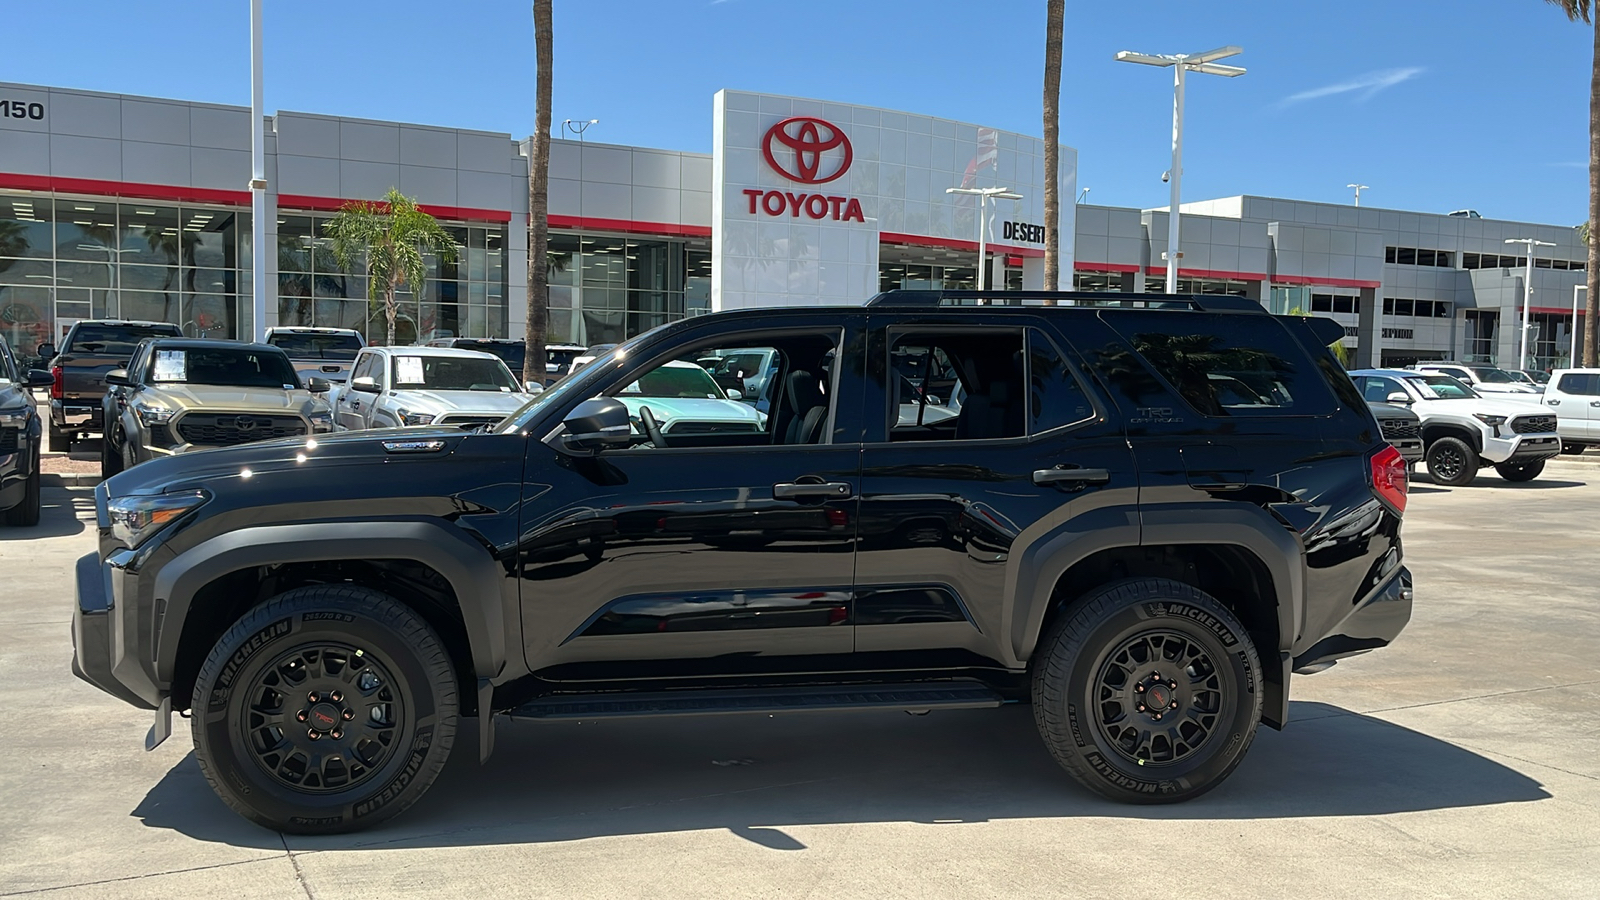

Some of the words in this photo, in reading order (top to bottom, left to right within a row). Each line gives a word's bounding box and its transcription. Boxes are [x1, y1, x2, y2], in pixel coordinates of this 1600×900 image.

[743, 189, 865, 222] TOYOTA
[1003, 221, 1045, 244] DESERT
[1136, 407, 1173, 418] TRD
[1168, 604, 1235, 644] MICHELIN
[221, 621, 289, 685] MICHELIN
[357, 754, 424, 817] MICHELIN
[1090, 753, 1157, 793] MICHELIN
